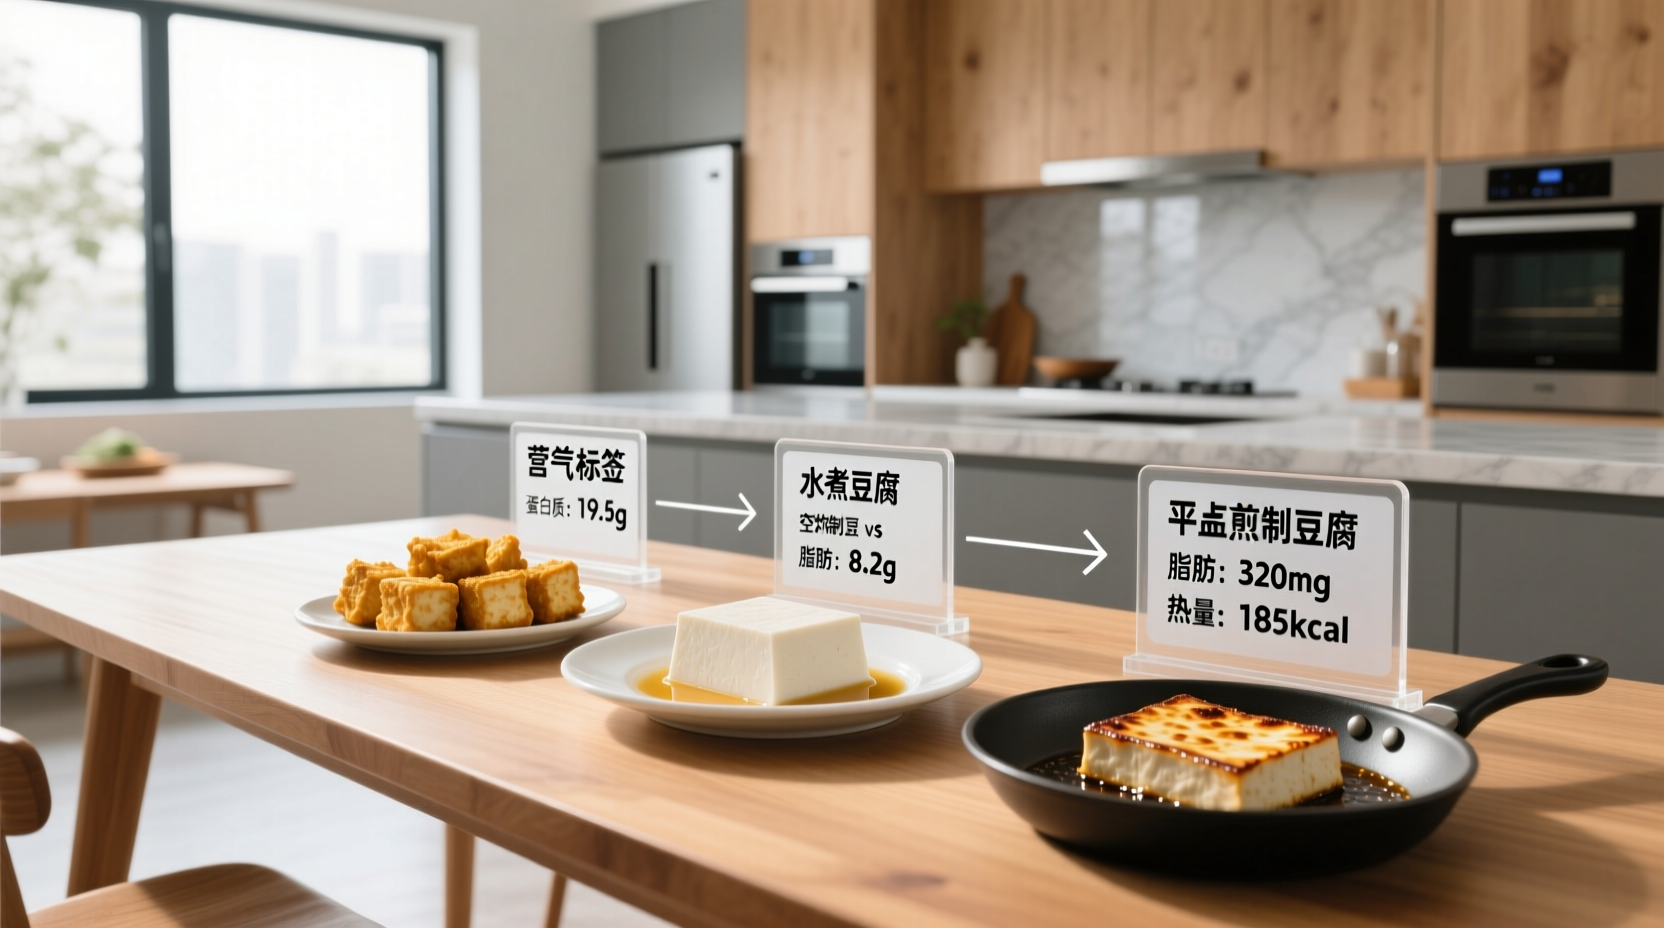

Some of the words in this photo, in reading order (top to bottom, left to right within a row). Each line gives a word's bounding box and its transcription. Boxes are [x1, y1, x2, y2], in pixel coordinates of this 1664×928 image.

[800, 466, 900, 506] 水煮豆腐
[578, 498, 627, 531] 19.5g
[865, 524, 883, 538] vs
[799, 545, 839, 570] 脂肪：
[849, 549, 897, 584] 8.2g
[1168, 552, 1225, 583] 脂肪：
[1238, 559, 1331, 603] 320mg
[1168, 594, 1223, 627] 热量：
[1239, 603, 1349, 644] 185kcal
